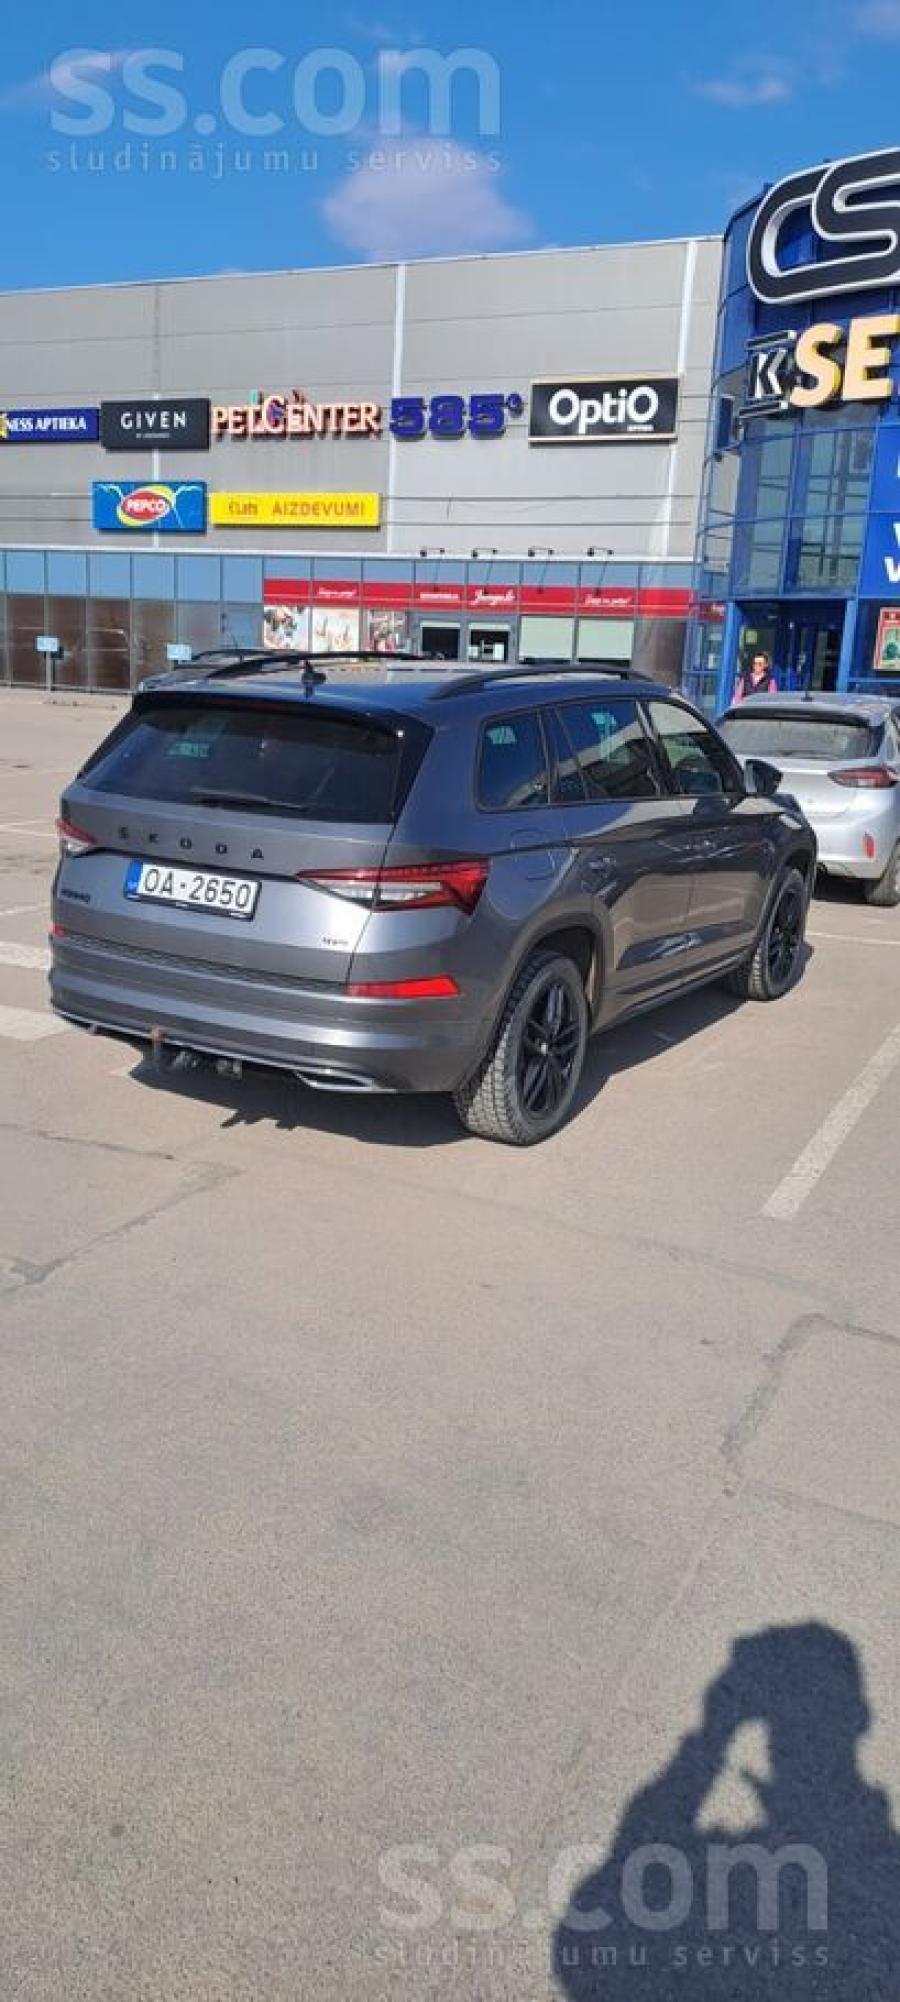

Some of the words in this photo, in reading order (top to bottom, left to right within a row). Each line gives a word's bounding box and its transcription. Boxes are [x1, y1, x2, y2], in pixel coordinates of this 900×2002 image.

[120, 410, 187, 430] GIVEN
[550, 386, 658, 434] OptiO
[127, 498, 167, 514] PEPCO
[272, 499, 366, 517] AIZDEVUMI
[118, 827, 264, 860] SKODA
